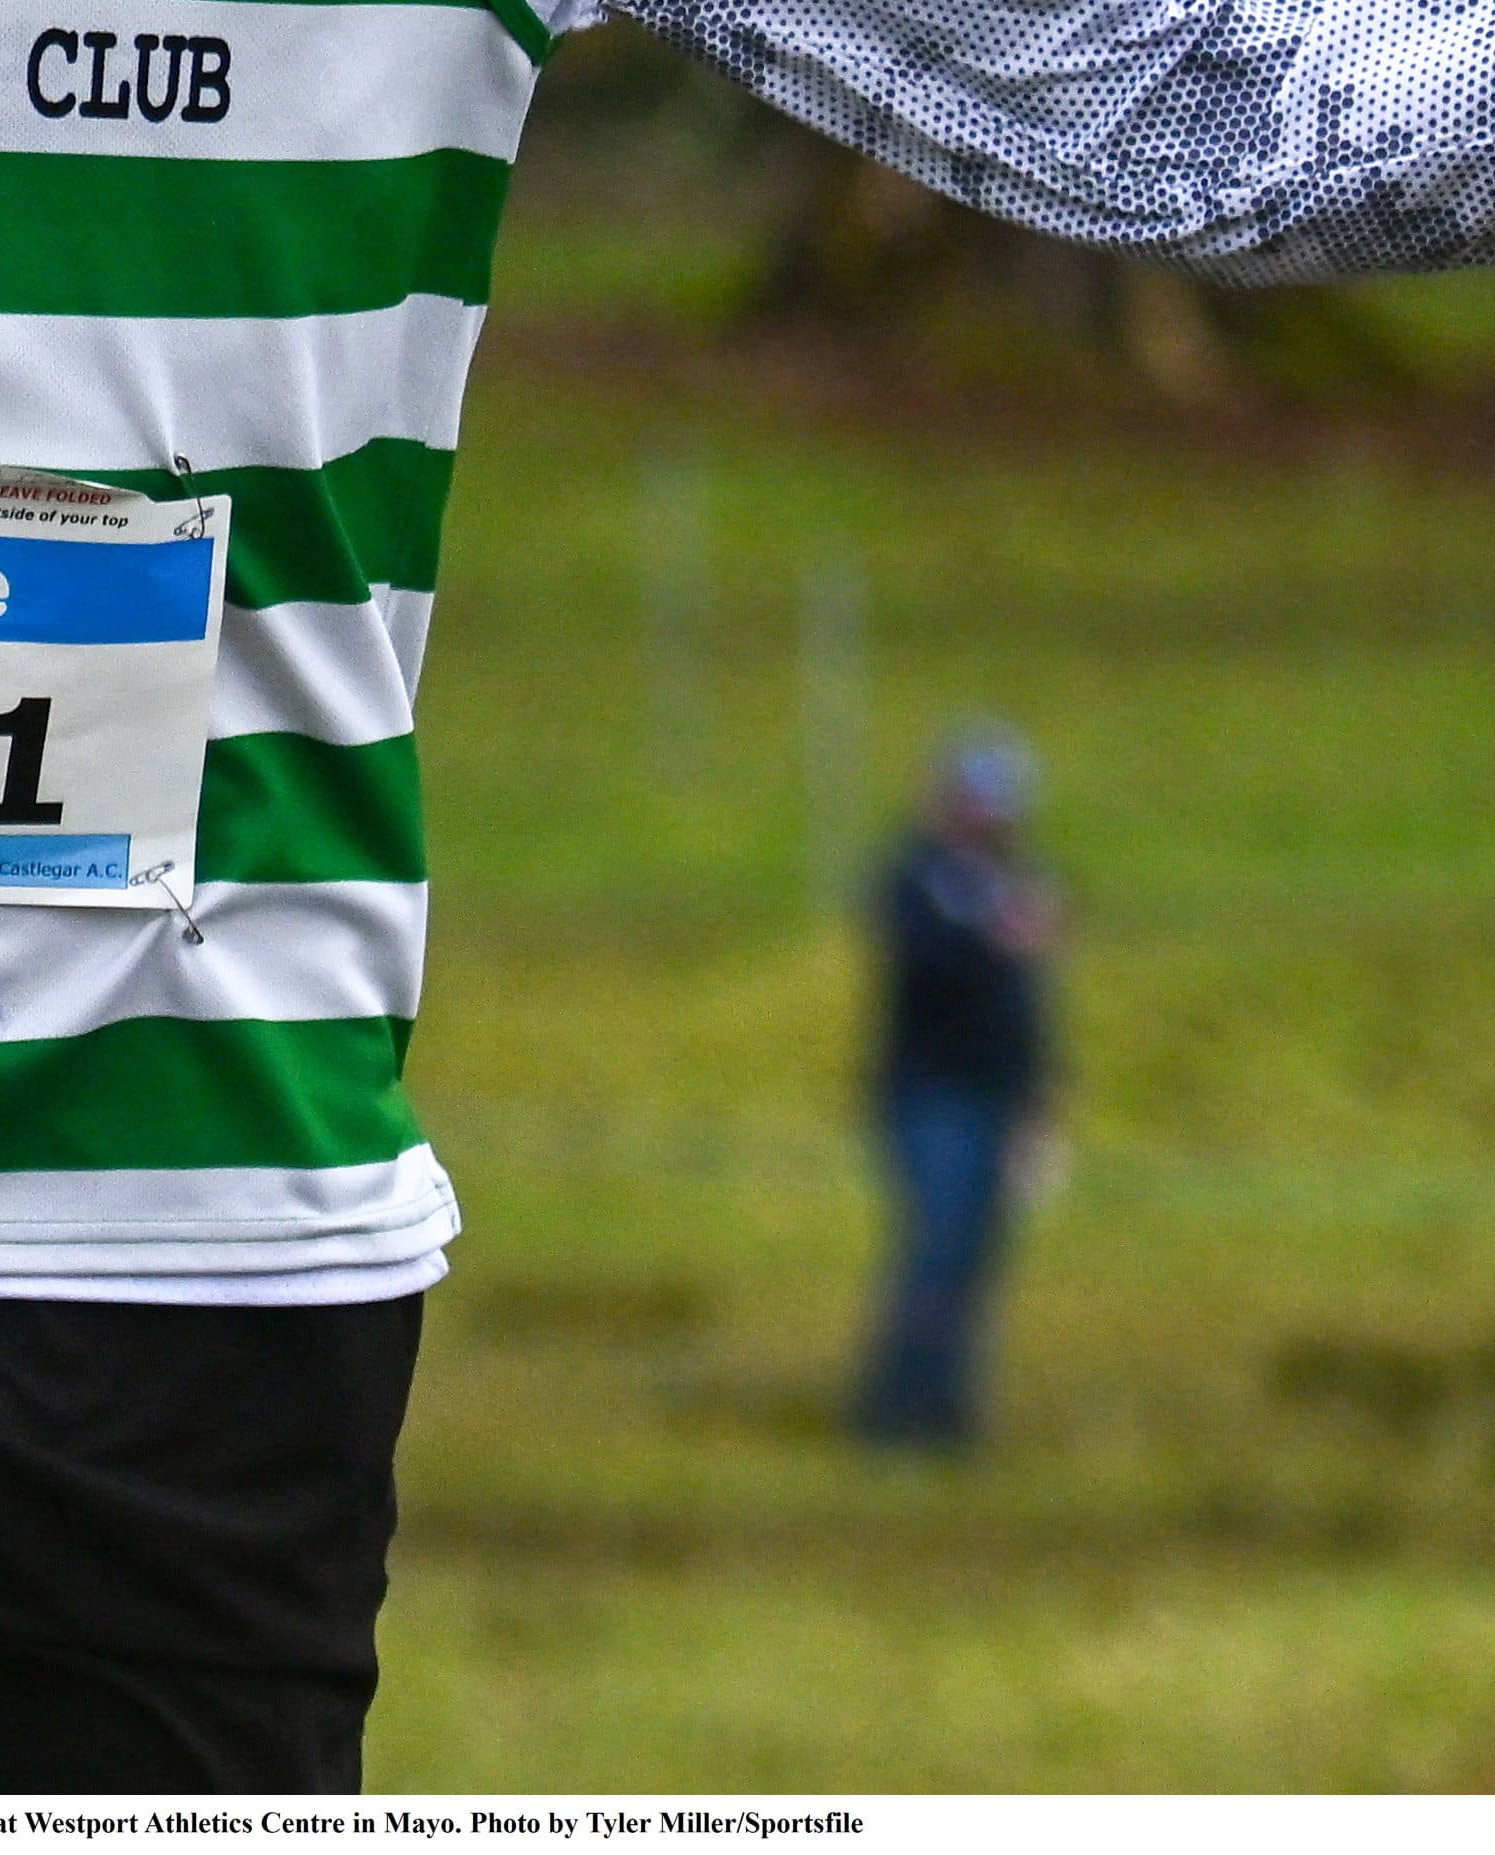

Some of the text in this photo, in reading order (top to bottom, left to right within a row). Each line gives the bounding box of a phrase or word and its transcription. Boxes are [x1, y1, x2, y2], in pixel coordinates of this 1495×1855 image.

[26, 28, 233, 124] CLUB
[45, 488, 112, 505] FOLDED
[39, 509, 58, 523] of
[60, 512, 99, 526] your
[101, 514, 129, 529] top
[86, 863, 123, 879] A.C.
